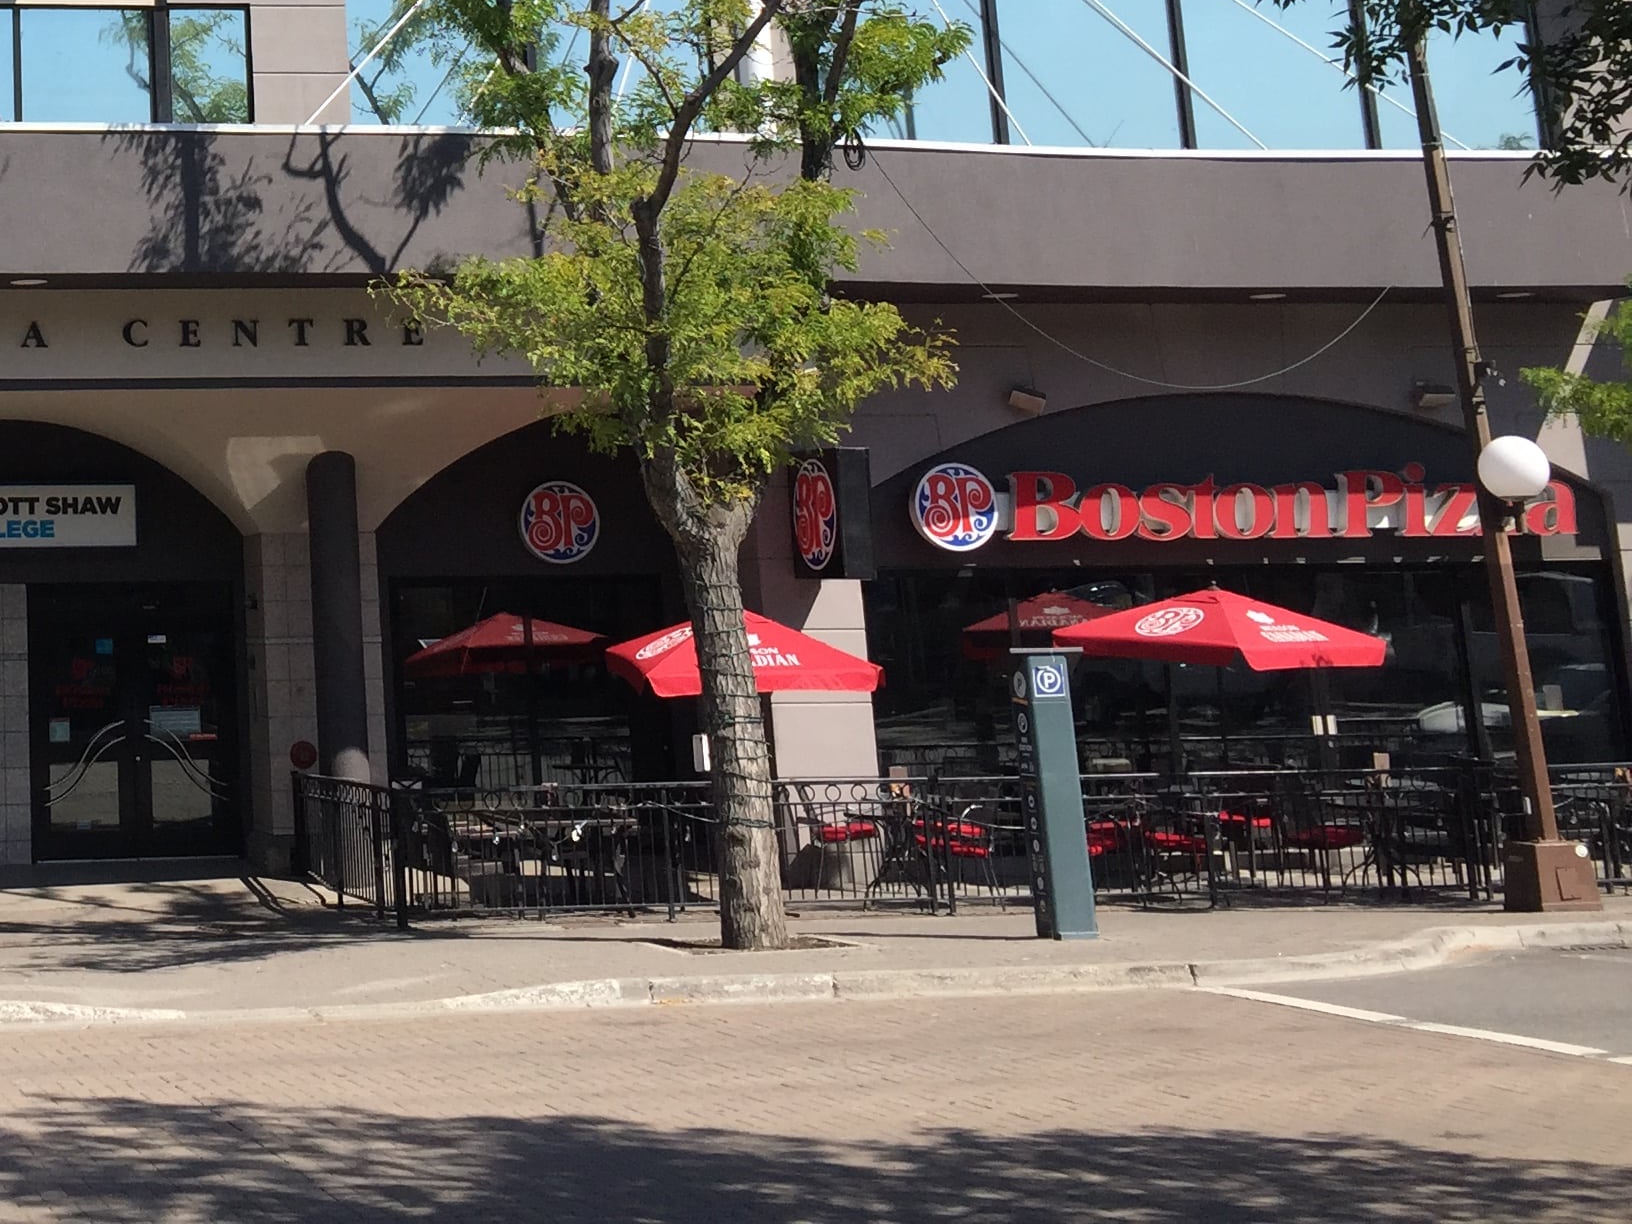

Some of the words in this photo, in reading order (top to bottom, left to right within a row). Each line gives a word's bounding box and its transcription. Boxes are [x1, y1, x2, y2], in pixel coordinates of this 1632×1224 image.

[122, 317, 424, 348] CENTRE
[45, 496, 122, 515] SHAW
[527, 489, 595, 552] BP
[923, 473, 993, 538] BP
[749, 647, 779, 655] SON
